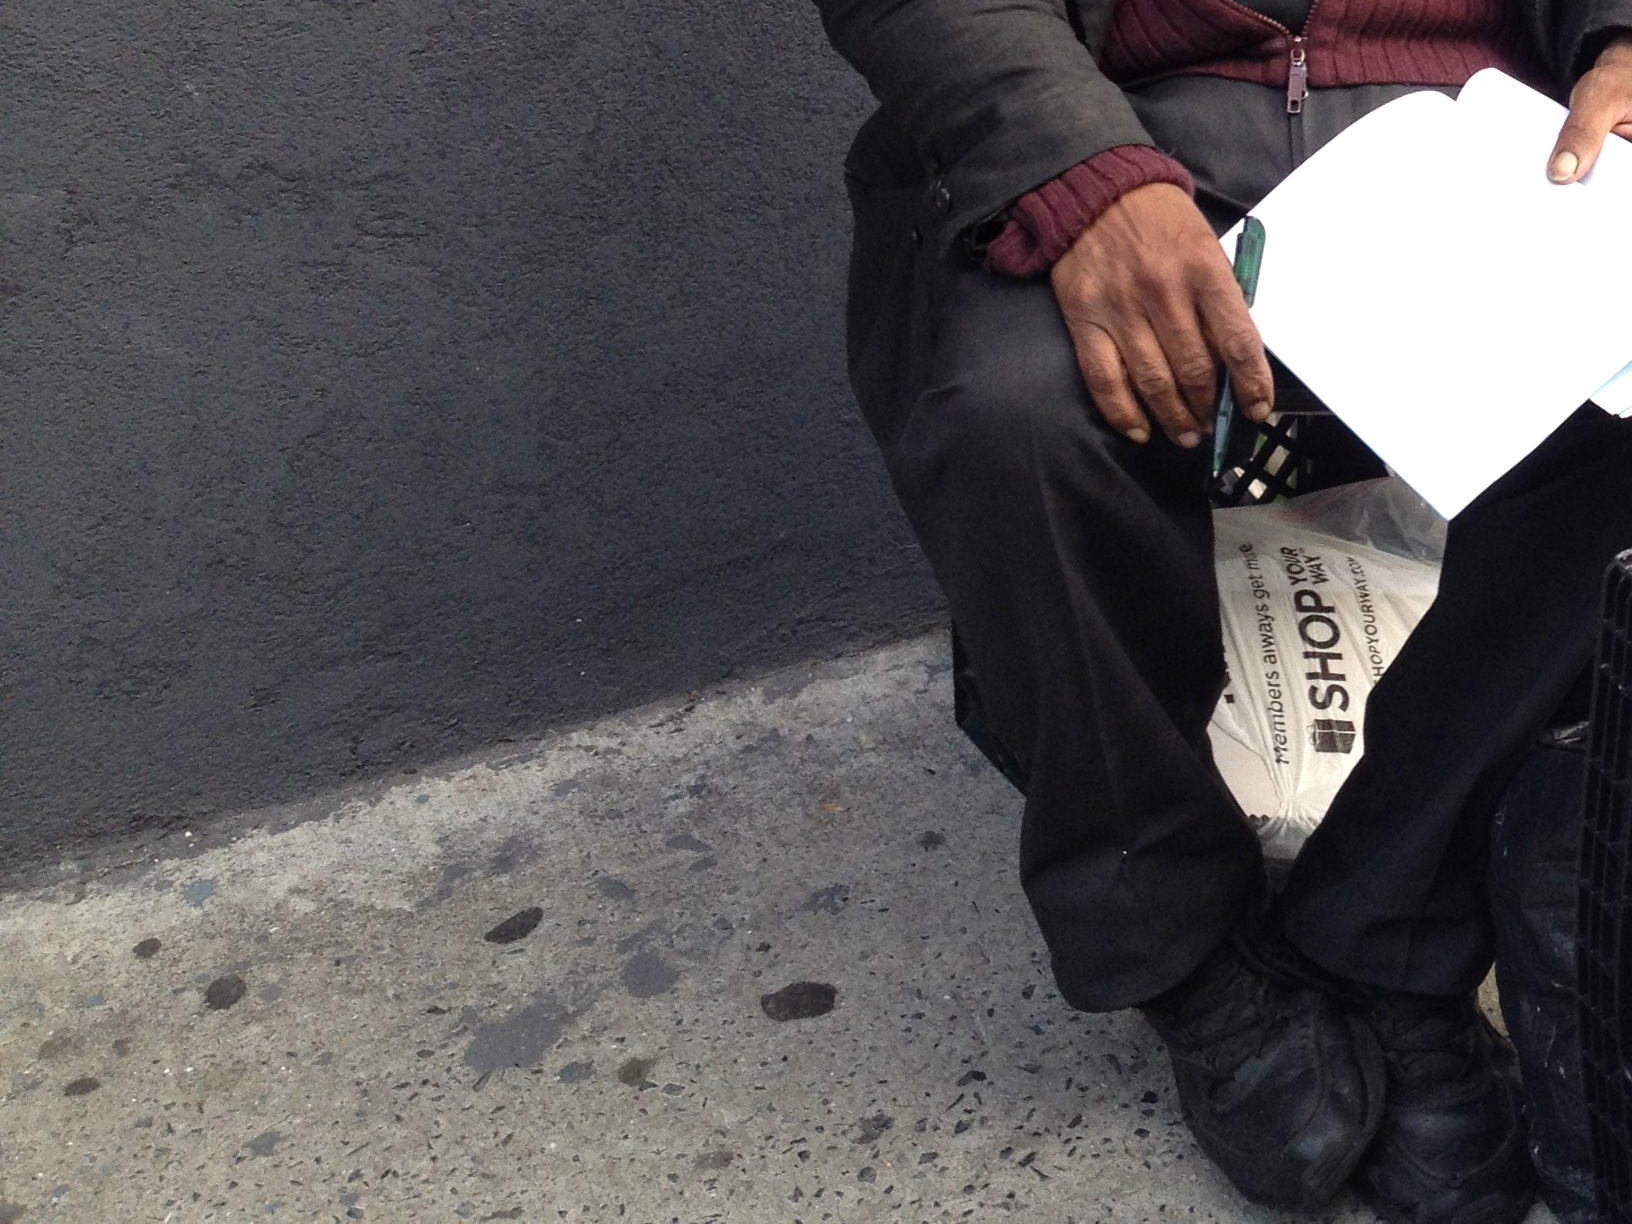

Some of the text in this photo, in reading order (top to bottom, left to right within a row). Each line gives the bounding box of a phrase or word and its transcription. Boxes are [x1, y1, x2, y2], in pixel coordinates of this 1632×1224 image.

[1280, 547, 1350, 712] SHOP YOUR
[1302, 554, 1330, 588] WAY
[1346, 556, 1384, 685] HOPYOURWAY.COM
[1239, 542, 1290, 765] Members always get me
